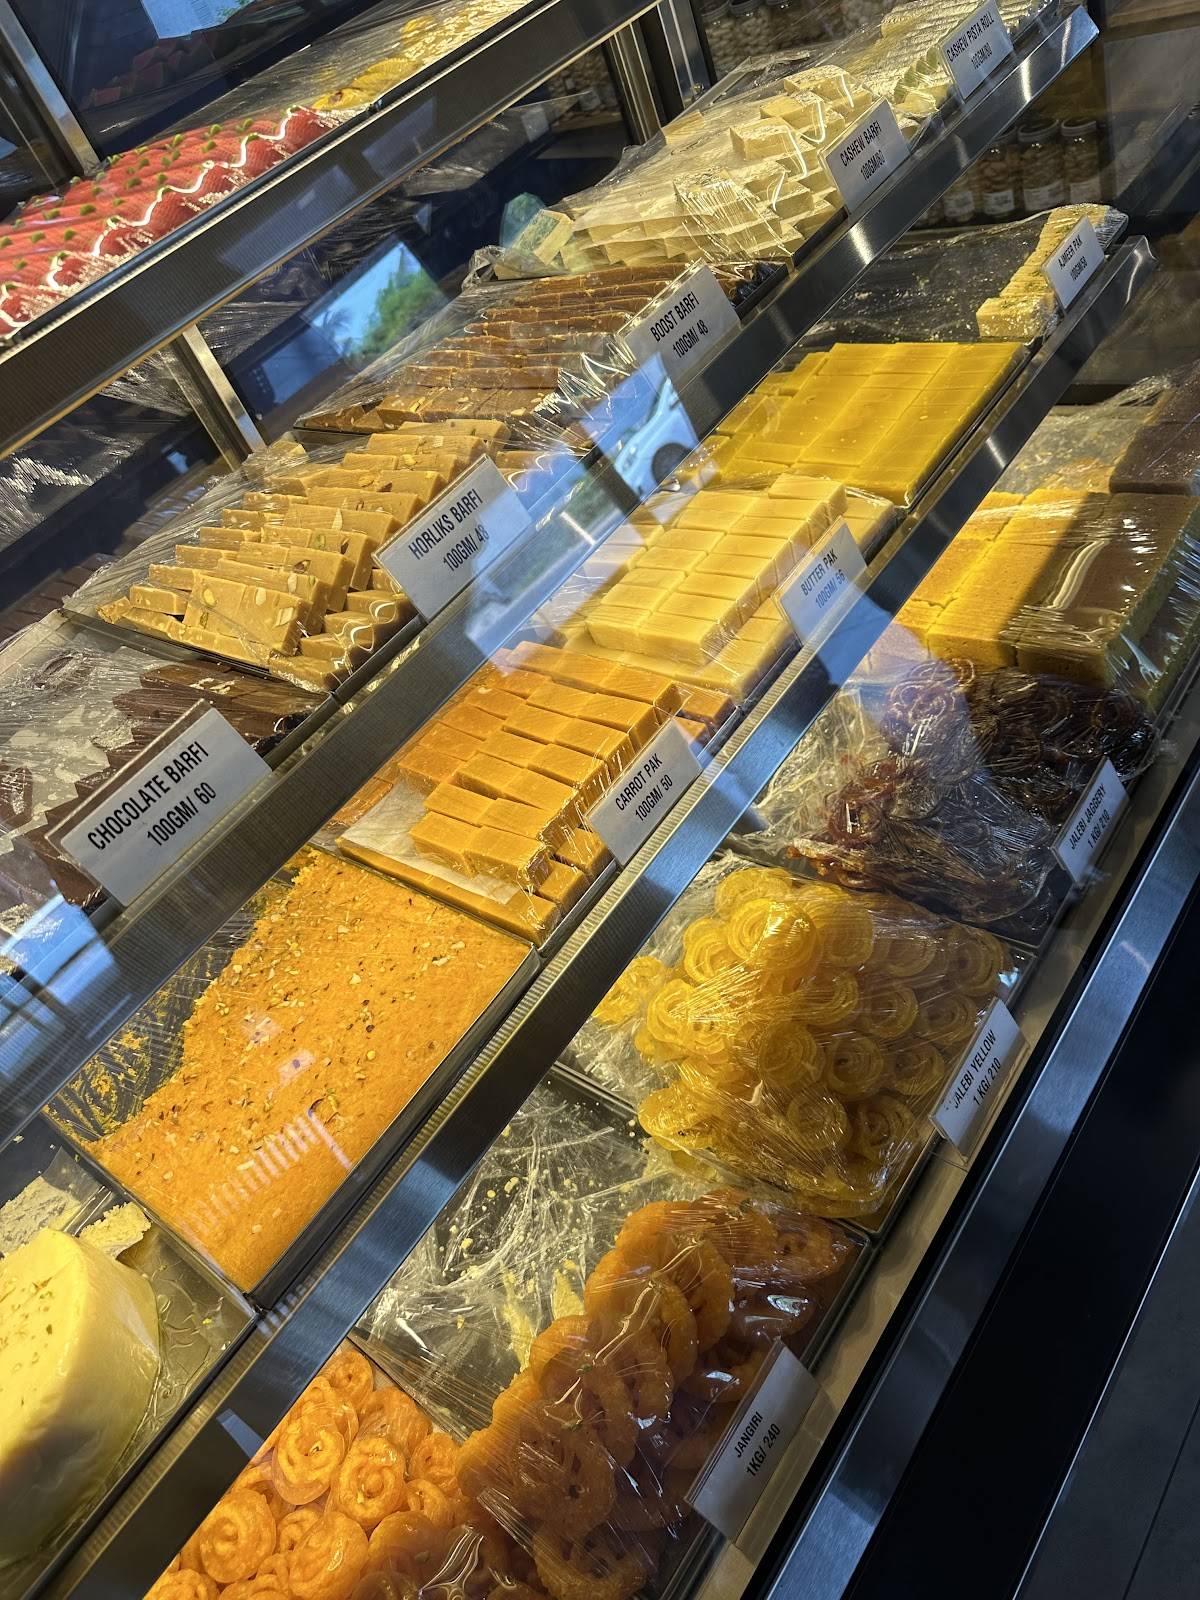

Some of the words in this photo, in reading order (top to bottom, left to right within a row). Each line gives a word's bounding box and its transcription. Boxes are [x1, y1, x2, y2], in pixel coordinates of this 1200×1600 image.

[946, 34, 969, 62] CASHEW
[966, 23, 981, 42] PISTA
[980, 11, 994, 31] ROLL
[840, 136, 866, 167] CASHEW
[863, 121, 882, 144] BARFI
[1058, 244, 1075, 270] AJMEER
[1072, 234, 1083, 251] PAK
[650, 310, 678, 342] BOOST
[674, 291, 700, 320] BARFI
[673, 326, 699, 358] 100GM/
[696, 320, 709, 337] 48
[408, 514, 455, 560] HORLIKS
[450, 488, 483, 523] BARFI
[443, 535, 479, 572] 100GM/
[474, 524, 490, 544] 48
[800, 563, 826, 597] BUTTER
[823, 548, 838, 570] PAK
[815, 578, 839, 609] 100GM/
[87, 774, 170, 850] CHOCOLATE
[163, 741, 209, 784] BARFI
[615, 770, 647, 811] CARROT
[643, 753, 663, 778] PAK
[635, 785, 663, 821] 100GM/
[660, 774, 673, 791] 50
[147, 796, 199, 846] 100GM/
[193, 782, 217, 805] 60
[1068, 818, 1087, 850] JALEBI
[1084, 783, 1106, 823] JAGGERY
[1098, 809, 1110, 828] 210
[953, 1070, 974, 1109] JALEBI
[970, 1029, 996, 1073] YELLOW
[976, 1076, 990, 1099] KG/
[987, 1057, 1001, 1080] 210
[973, 1095, 980, 1106] 1
[732, 1411, 764, 1458] JANGIRI
[746, 1446, 767, 1477] 1KG/
[763, 1423, 781, 1449] 240
